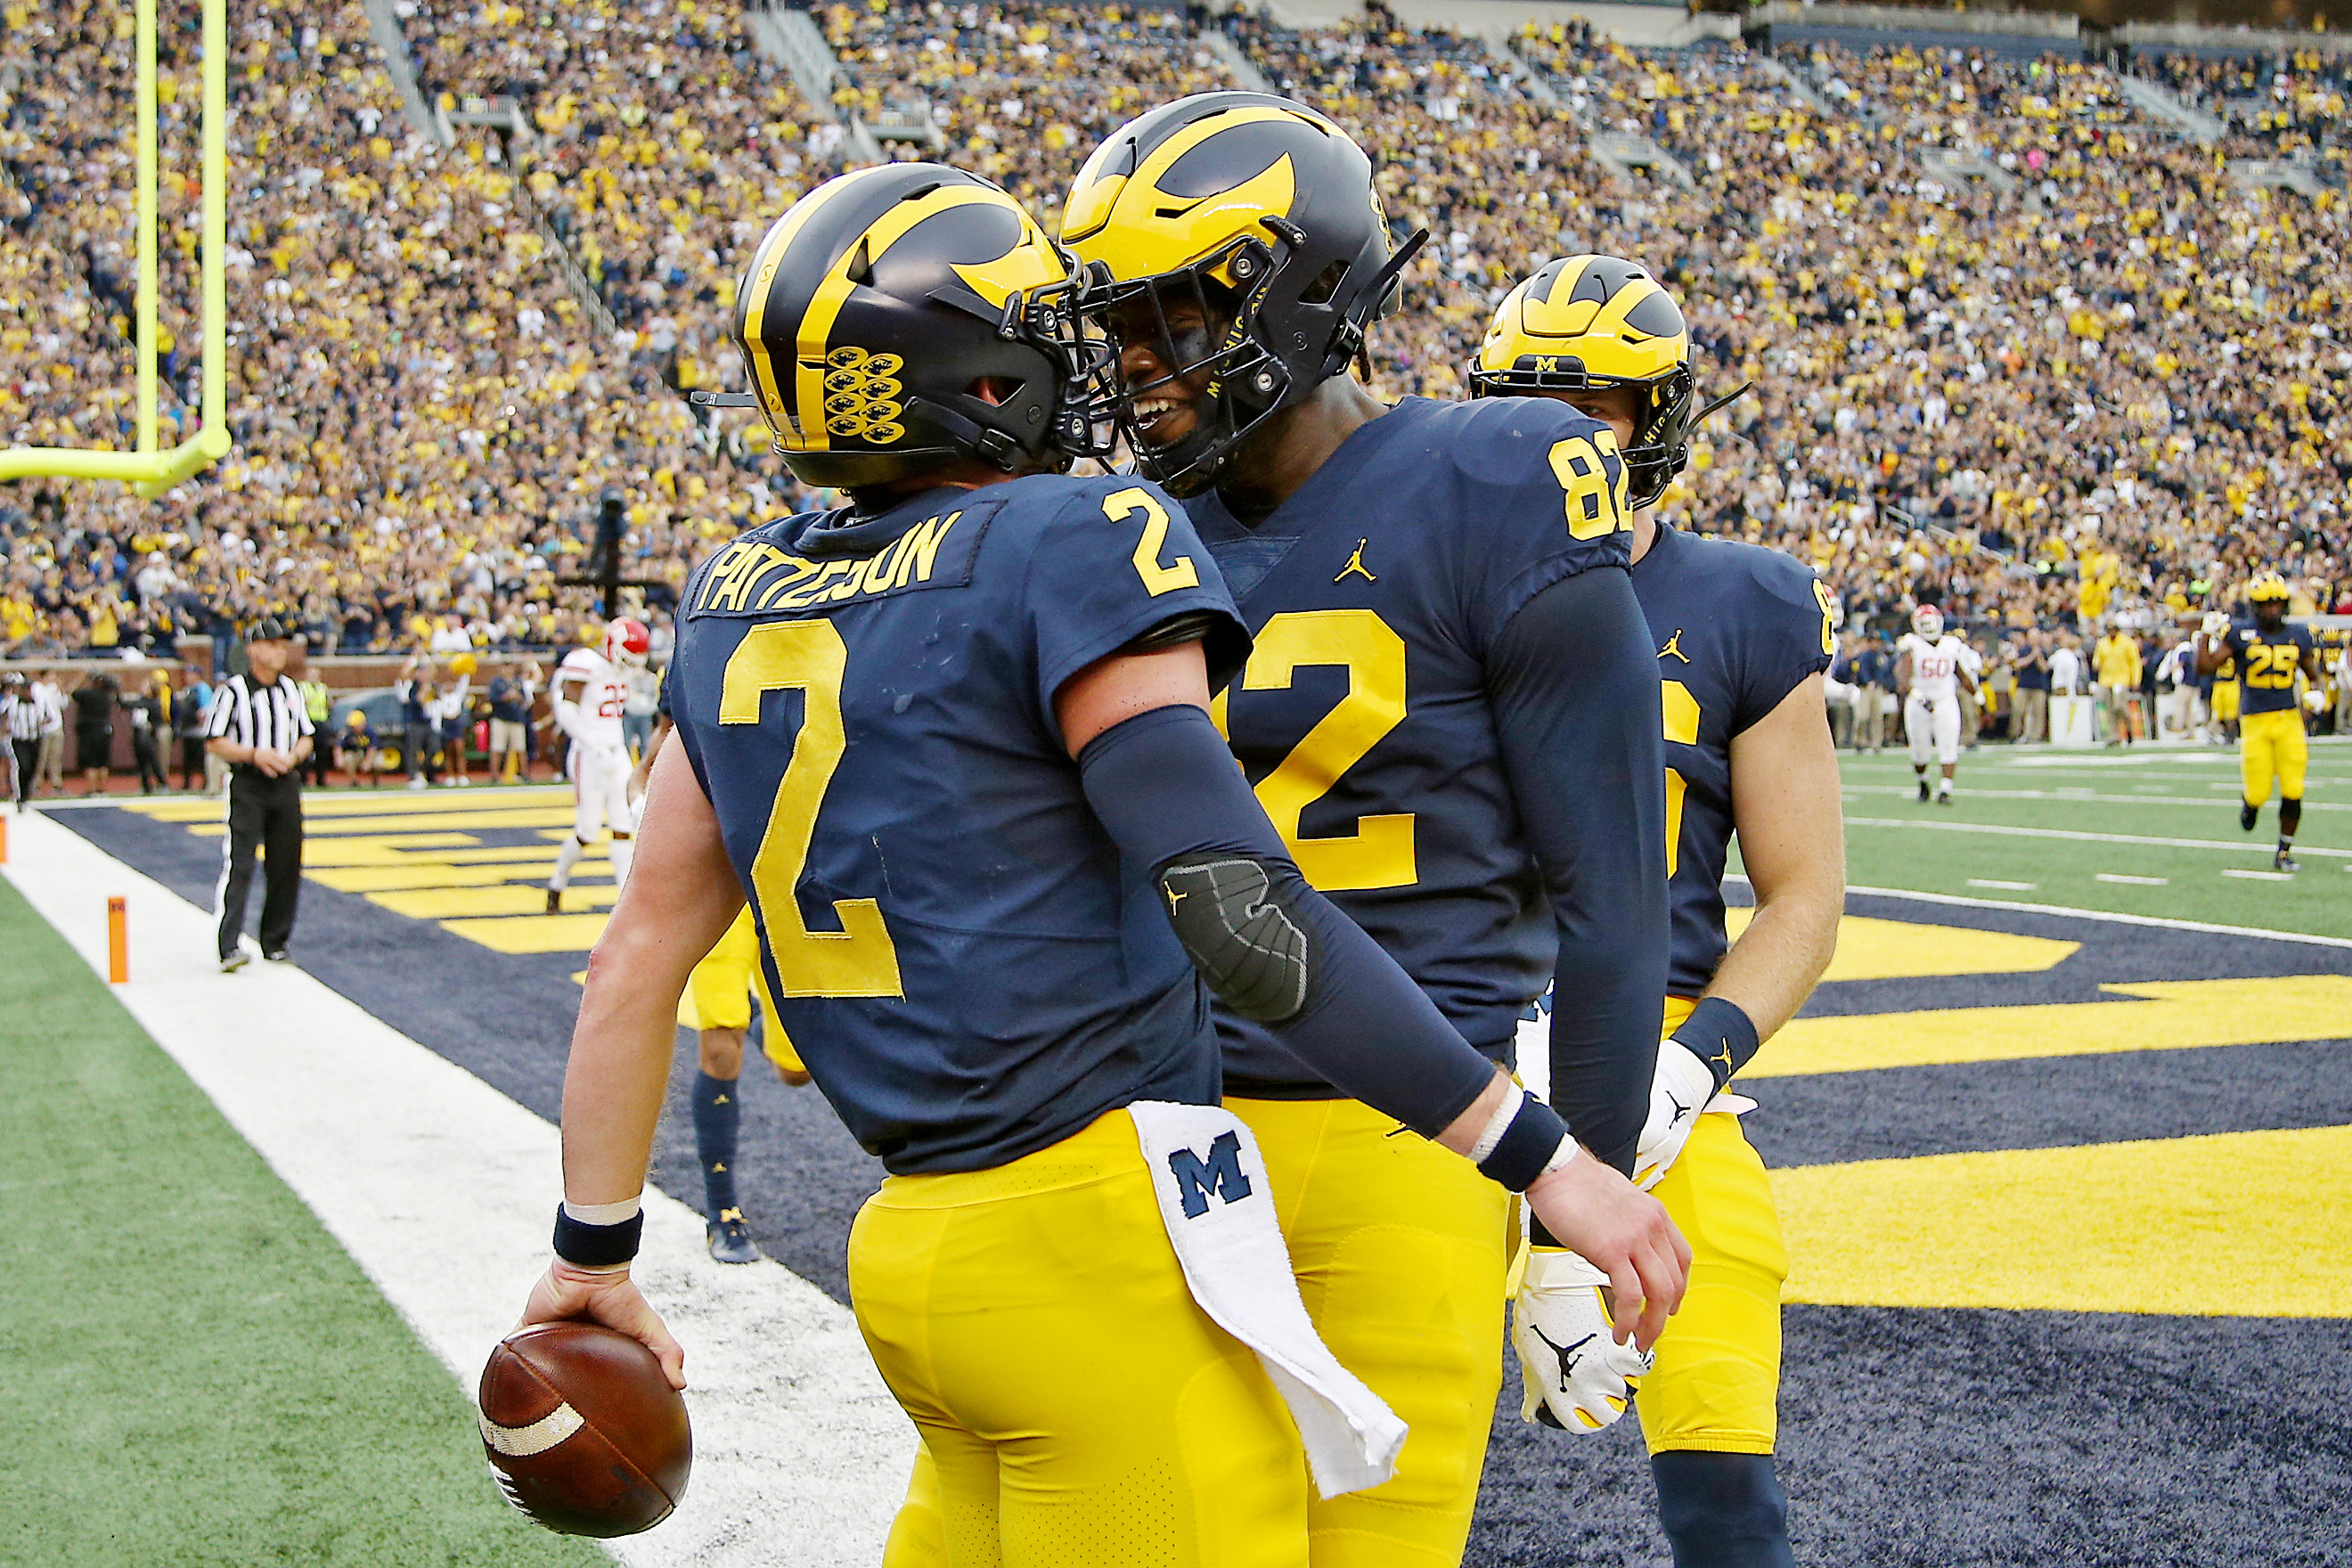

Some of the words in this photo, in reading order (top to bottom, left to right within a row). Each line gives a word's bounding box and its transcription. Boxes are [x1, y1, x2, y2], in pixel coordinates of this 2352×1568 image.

[1534, 355, 1558, 372] M
[1548, 429, 1634, 542] 82
[1101, 486, 1201, 598] 2
[1922, 657, 1949, 679] 50
[2244, 644, 2300, 690] 25
[1210, 608, 1418, 892] 2
[719, 617, 902, 999] 2
[1168, 1130, 1253, 1220] M
